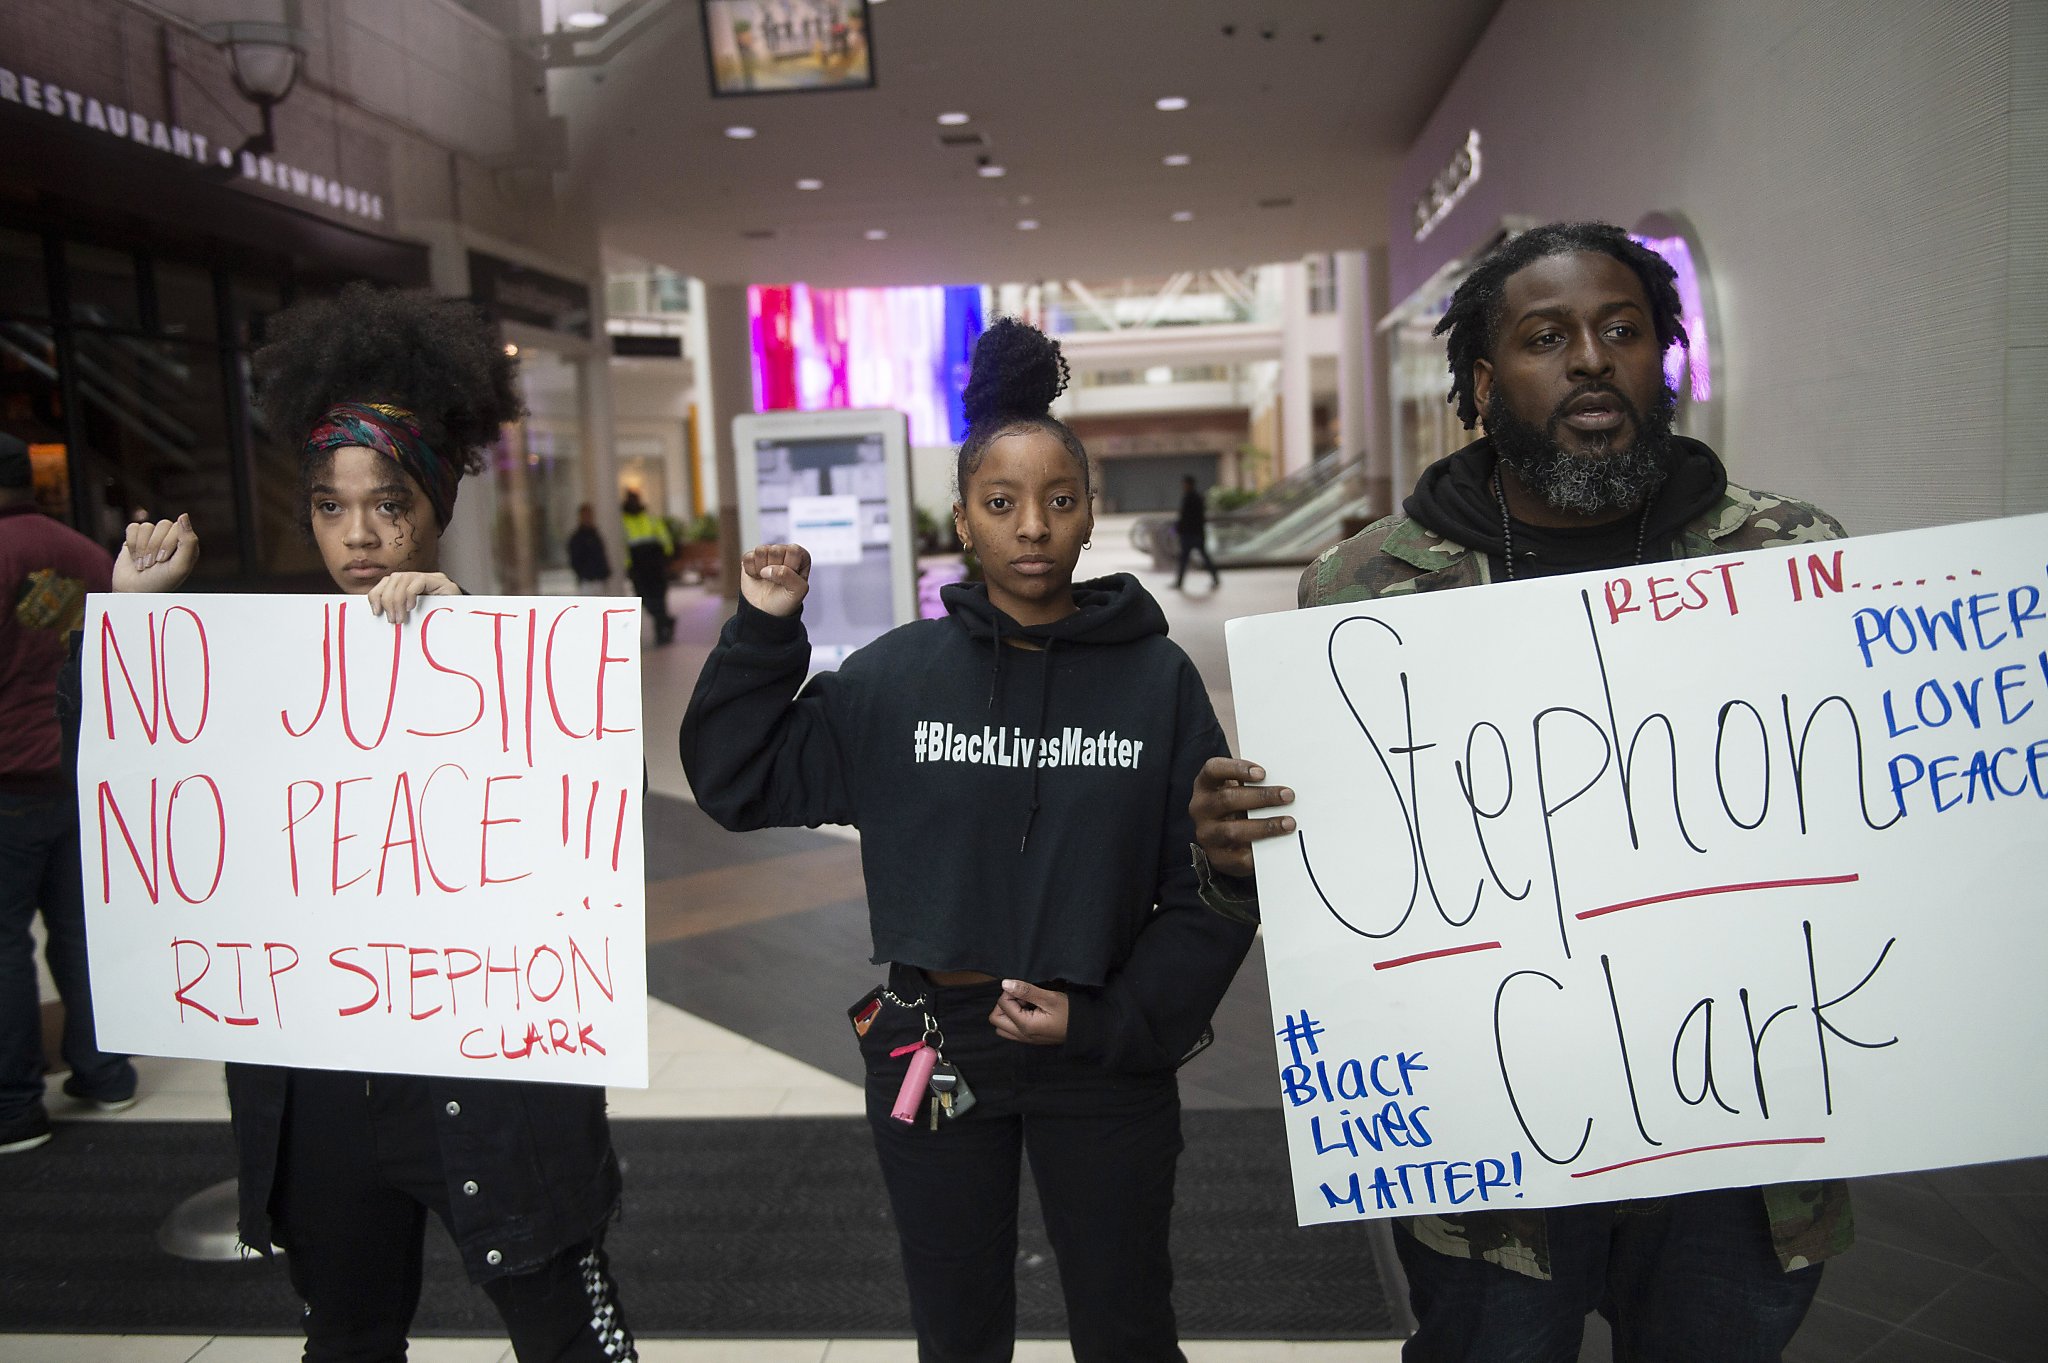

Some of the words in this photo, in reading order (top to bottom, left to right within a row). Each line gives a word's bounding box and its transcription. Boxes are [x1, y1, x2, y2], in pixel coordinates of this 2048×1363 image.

[0, 68, 208, 163] RESTAURANT
[1604, 562, 1744, 625] REST
[1853, 564, 2048, 668] POWER
[100, 605, 210, 745] NO
[281, 602, 635, 768] JUSTICE
[914, 720, 1144, 769] #BlackLivesMatter
[1298, 589, 1904, 960] Stephon
[97, 774, 226, 906] NO
[171, 936, 300, 1028] RIP
[329, 934, 615, 1021] STEPHON
[459, 1019, 607, 1060] CLARK
[1276, 1009, 1325, 1066] #
[1493, 921, 1899, 1166] Clark
[1311, 1101, 1432, 1157] Lives
[1319, 1151, 1523, 1214] MATTER!
